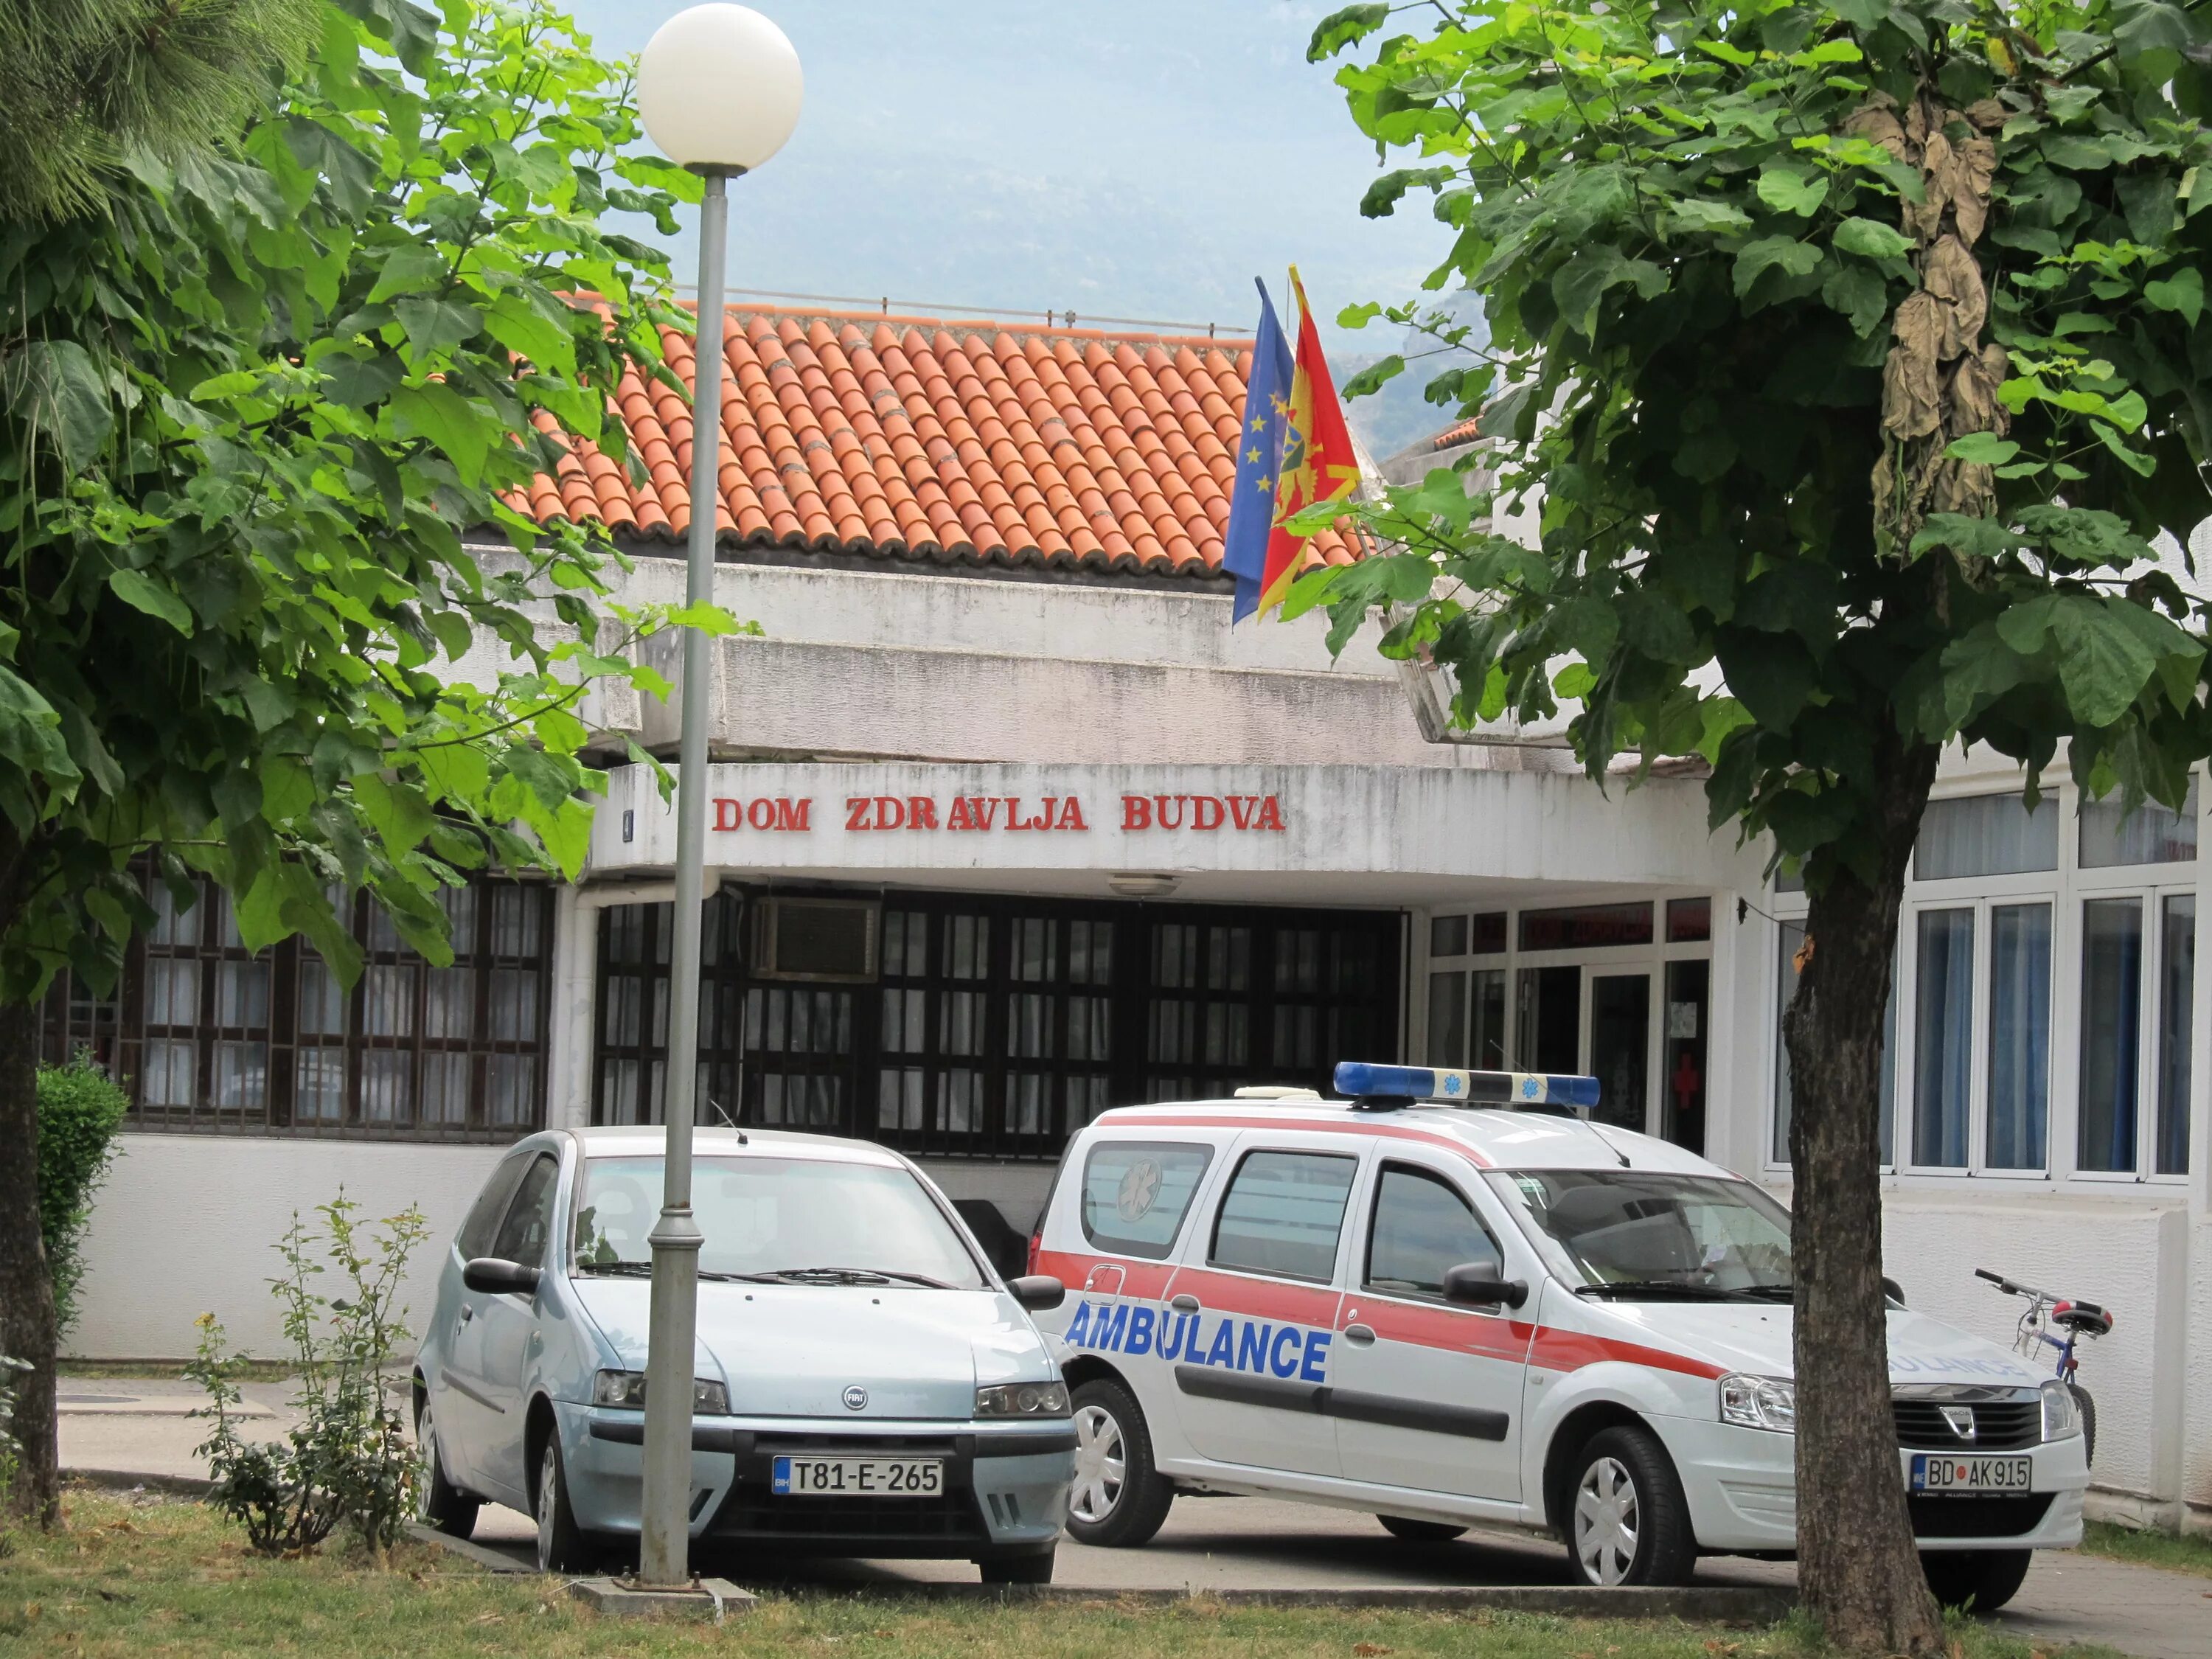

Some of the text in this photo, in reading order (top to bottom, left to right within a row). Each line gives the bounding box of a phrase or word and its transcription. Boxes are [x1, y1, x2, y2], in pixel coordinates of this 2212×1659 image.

[712, 796, 1286, 831] DOM ZDRAVLJA BUDVA
[1061, 1300, 1332, 1383] AMBULANCE
[847, 1393, 863, 1402] FIAT
[775, 1462, 938, 1491] BIH T81-E-265
[1929, 1460, 1954, 1486] BD
[1969, 1460, 2028, 1486] AK915
